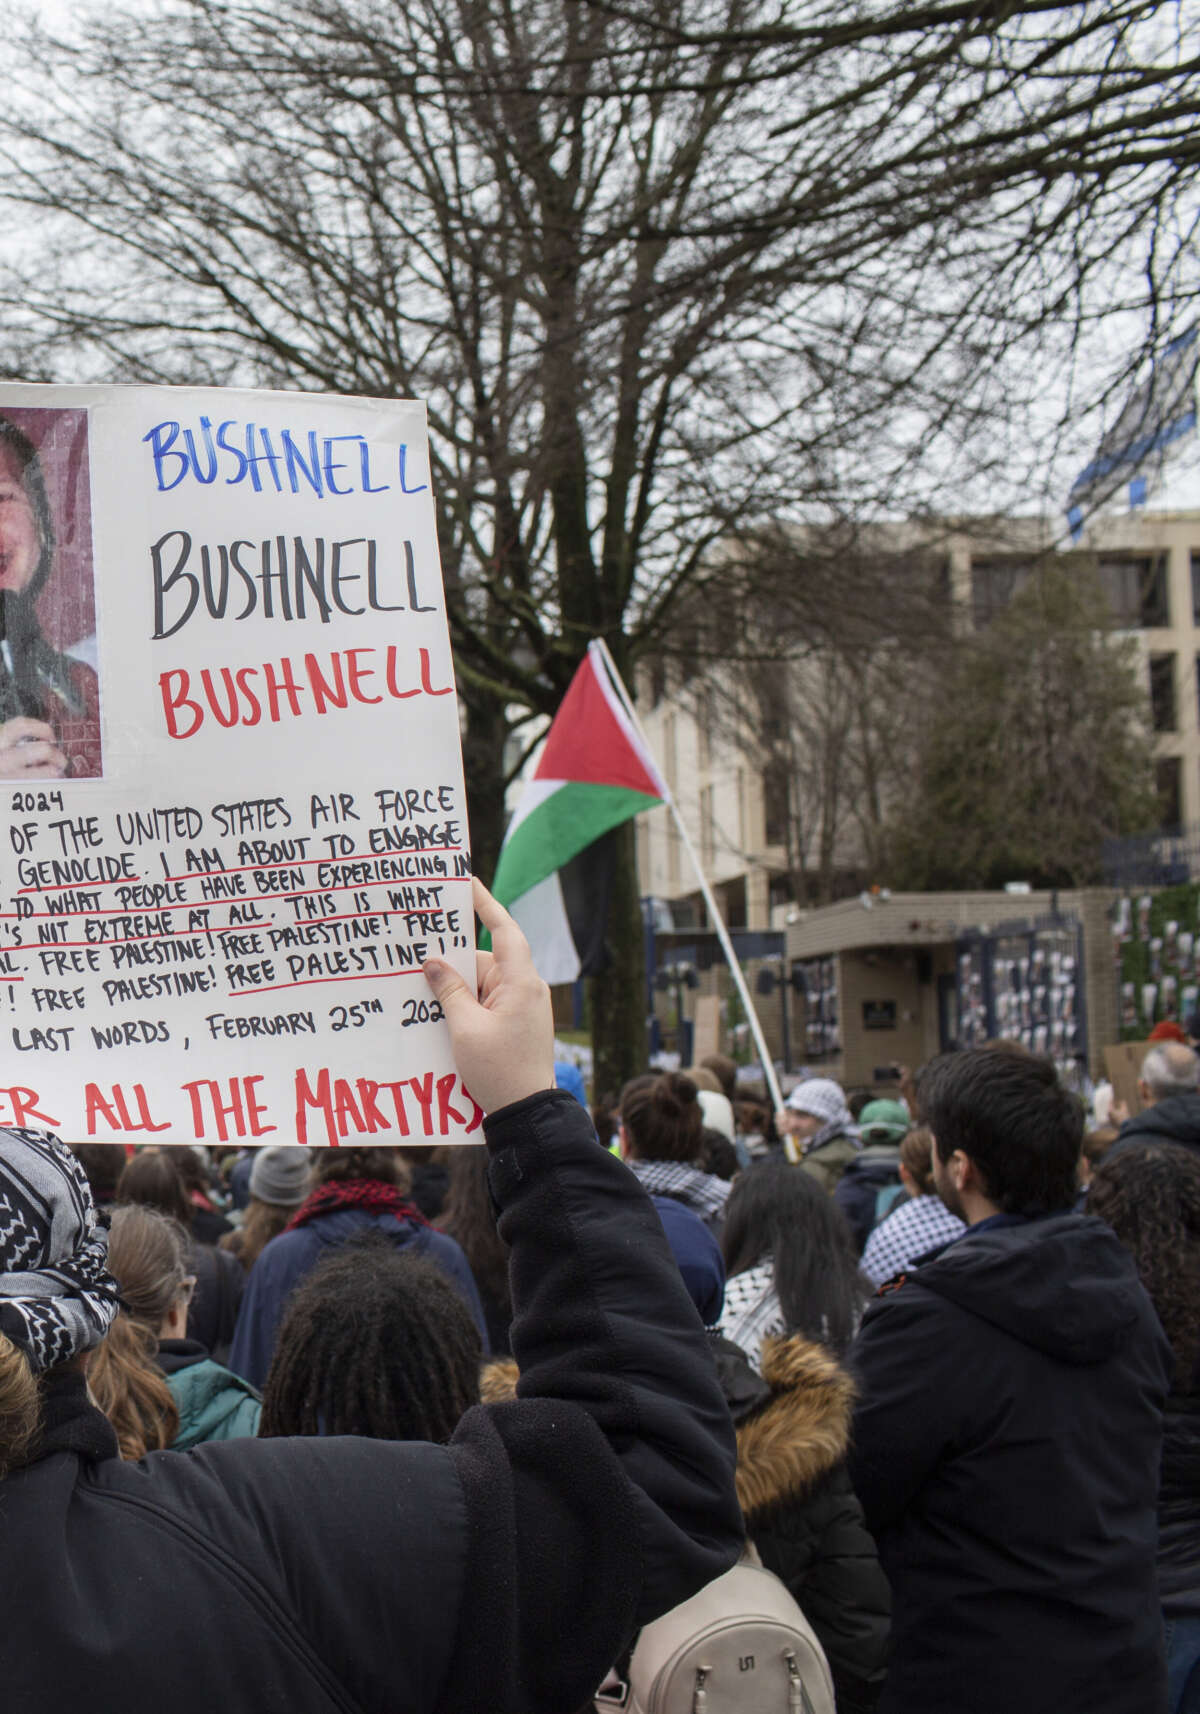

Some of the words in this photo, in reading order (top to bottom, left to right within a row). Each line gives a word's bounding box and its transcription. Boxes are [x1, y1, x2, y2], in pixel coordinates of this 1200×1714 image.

[142, 416, 428, 499] BUSHNELL
[149, 529, 438, 641] BUSHNELL
[158, 645, 455, 740] BUSHNELL
[10, 823, 38, 854] OF
[48, 816, 103, 856] THE
[116, 807, 202, 845] UNITED
[211, 798, 291, 837] STATES
[311, 793, 360, 829] AIR
[375, 786, 454, 822] FORCE
[11, 791, 64, 812] 2024
[10, 897, 34, 921] TO
[45, 891, 102, 915] WHAT
[115, 882, 187, 911] PEOPLE
[200, 873, 247, 901] HAVE
[253, 867, 305, 894] BEEN
[318, 854, 447, 888] EXPERIENCING
[454, 852, 471, 877] IN
[17, 852, 149, 892] GENOCIDE.
[160, 852, 170, 878] I
[185, 847, 226, 872] AM
[238, 837, 311, 865] ABOUT
[323, 834, 355, 859] TO
[369, 821, 461, 854] ENGAGE
[38, 948, 101, 976] FREE
[109, 931, 216, 970] PALESTINE!
[217, 930, 264, 960] FREE
[267, 912, 391, 951] PALESTINE!
[402, 909, 460, 937] FREE
[85, 911, 174, 943] EXTREME
[189, 909, 209, 932] AT
[229, 902, 276, 925] ALL.
[284, 893, 337, 920] THIS
[353, 891, 371, 914] IS
[386, 886, 444, 912] WHAT
[31, 986, 85, 1012] FREE
[102, 964, 217, 1007] PALESTINE!
[225, 959, 275, 989] FREE
[12, 1027, 75, 1051] LAST
[205, 1011, 317, 1040] FEBRUARY
[328, 999, 384, 1032] 25TH
[401, 999, 446, 1027] 202
[84, 1081, 171, 1135] ALL
[181, 1073, 278, 1142] THE
[294, 1067, 484, 1147] MARTYRS
